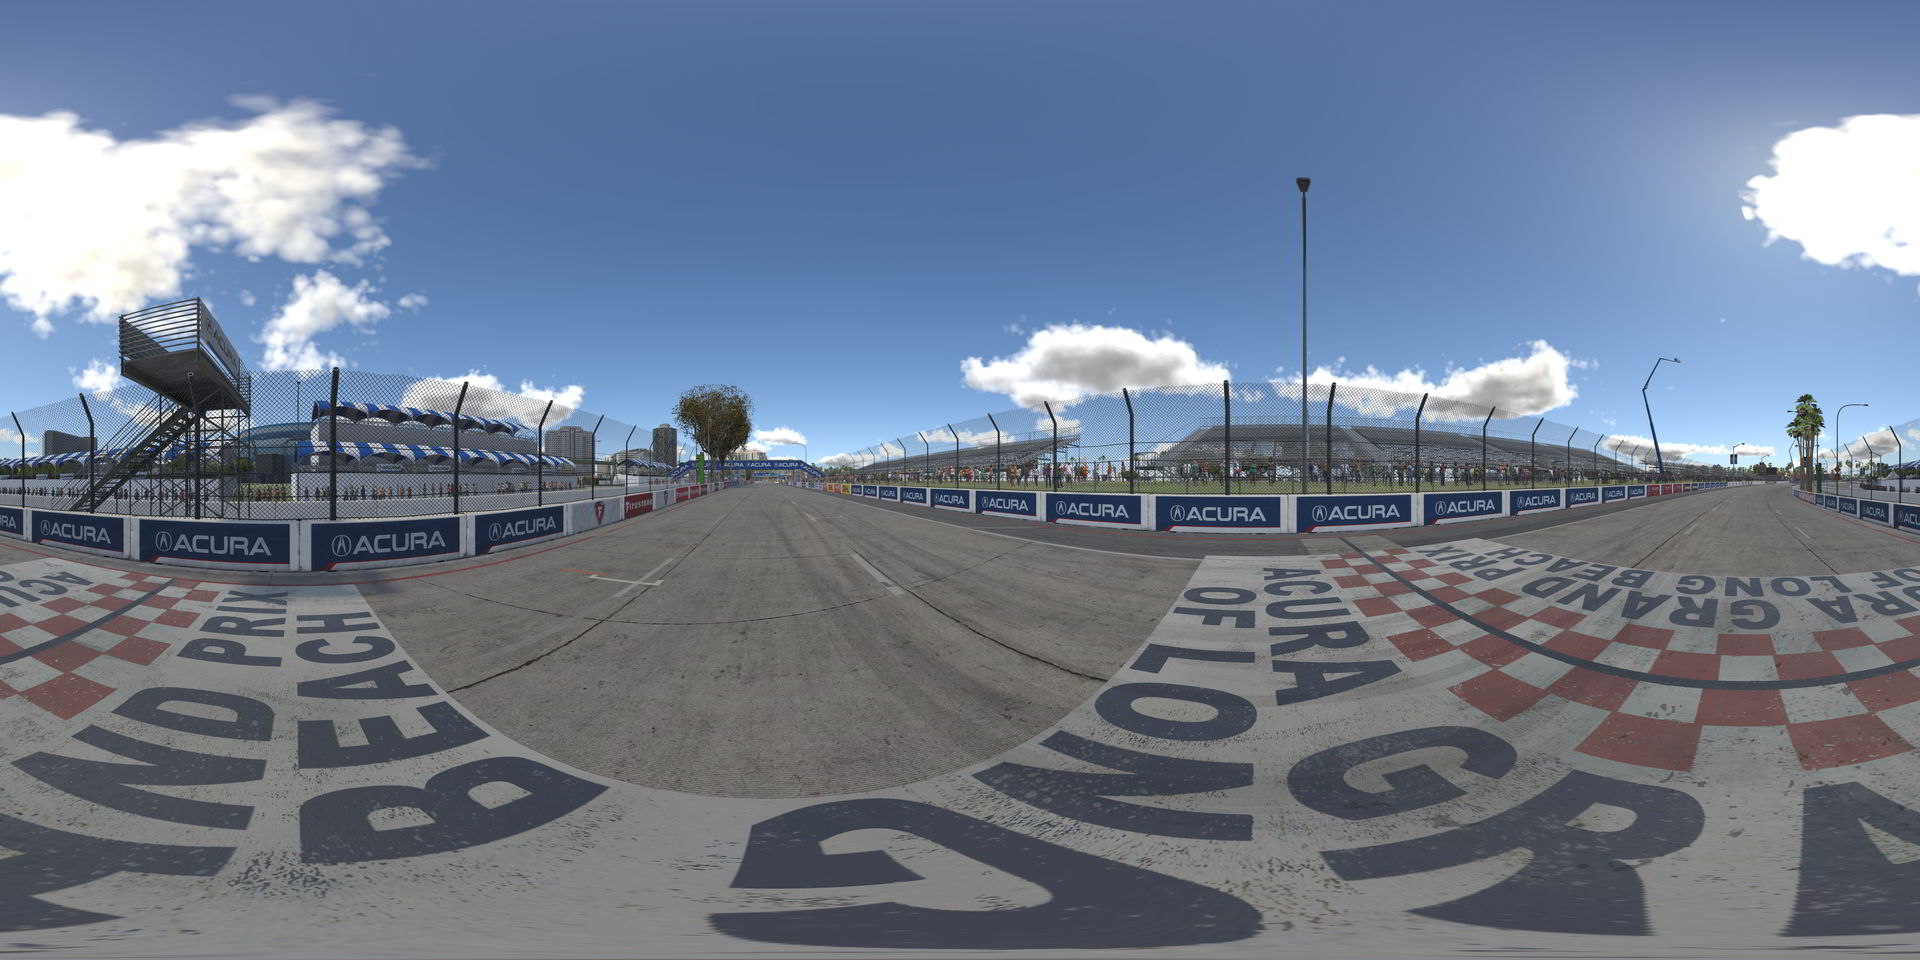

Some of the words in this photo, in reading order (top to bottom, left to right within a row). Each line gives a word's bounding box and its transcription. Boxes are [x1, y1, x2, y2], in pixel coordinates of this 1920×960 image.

[906, 491, 924, 501] ACURA
[939, 493, 965, 505] ACURA
[989, 497, 1029, 511] ACURA
[1524, 496, 1556, 507] ACURA
[1574, 492, 1595, 502] ACURA
[1608, 489, 1624, 498] ACURA
[1066, 502, 1129, 518] ACURA
[1185, 506, 1267, 522] ACURA
[1328, 504, 1400, 521] ACURA
[1447, 499, 1495, 513] ACURA
[1866, 507, 1886, 519] ACURA
[51, 522, 111, 544] ACURA
[502, 516, 556, 539] ACURA
[173, 534, 272, 556] ACURA
[352, 531, 446, 555] ACURA
[1416, 546, 1527, 582] PRIX
[1483, 547, 1656, 589] BEACH
[1675, 575, 1853, 597] LONG
[1173, 586, 1257, 629] OF
[1521, 576, 1780, 630] GRAND
[176, 590, 289, 667] PRIX
[1262, 567, 1402, 706] ACURA
[295, 611, 610, 866] BEACH
[707, 643, 1264, 950] LONG
